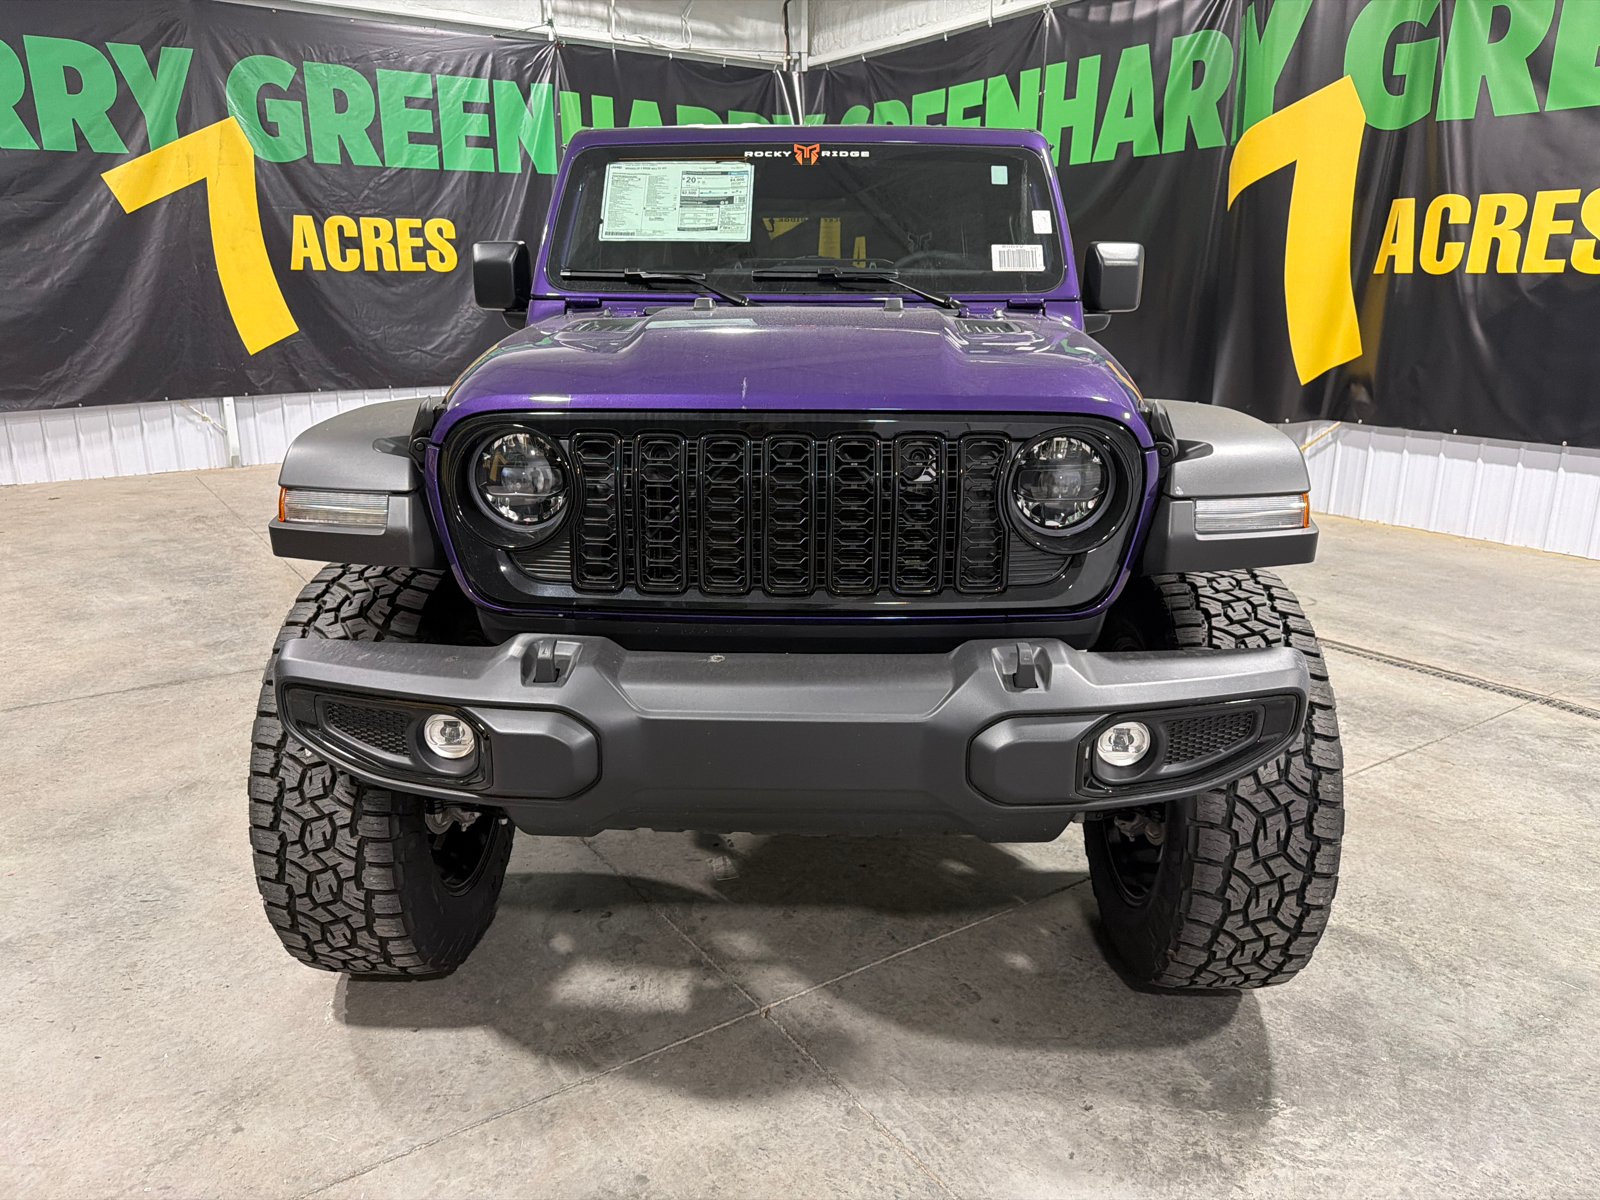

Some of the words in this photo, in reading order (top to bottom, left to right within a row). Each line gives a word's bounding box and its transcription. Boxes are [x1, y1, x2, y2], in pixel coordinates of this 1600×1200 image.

[226, 54, 558, 174] GREEN
[744, 150, 792, 158] ROCKY
[821, 150, 870, 158] RIDGE
[100, 115, 299, 356] 7
[290, 215, 458, 273] ACRES
[1227, 74, 1366, 386] 7
